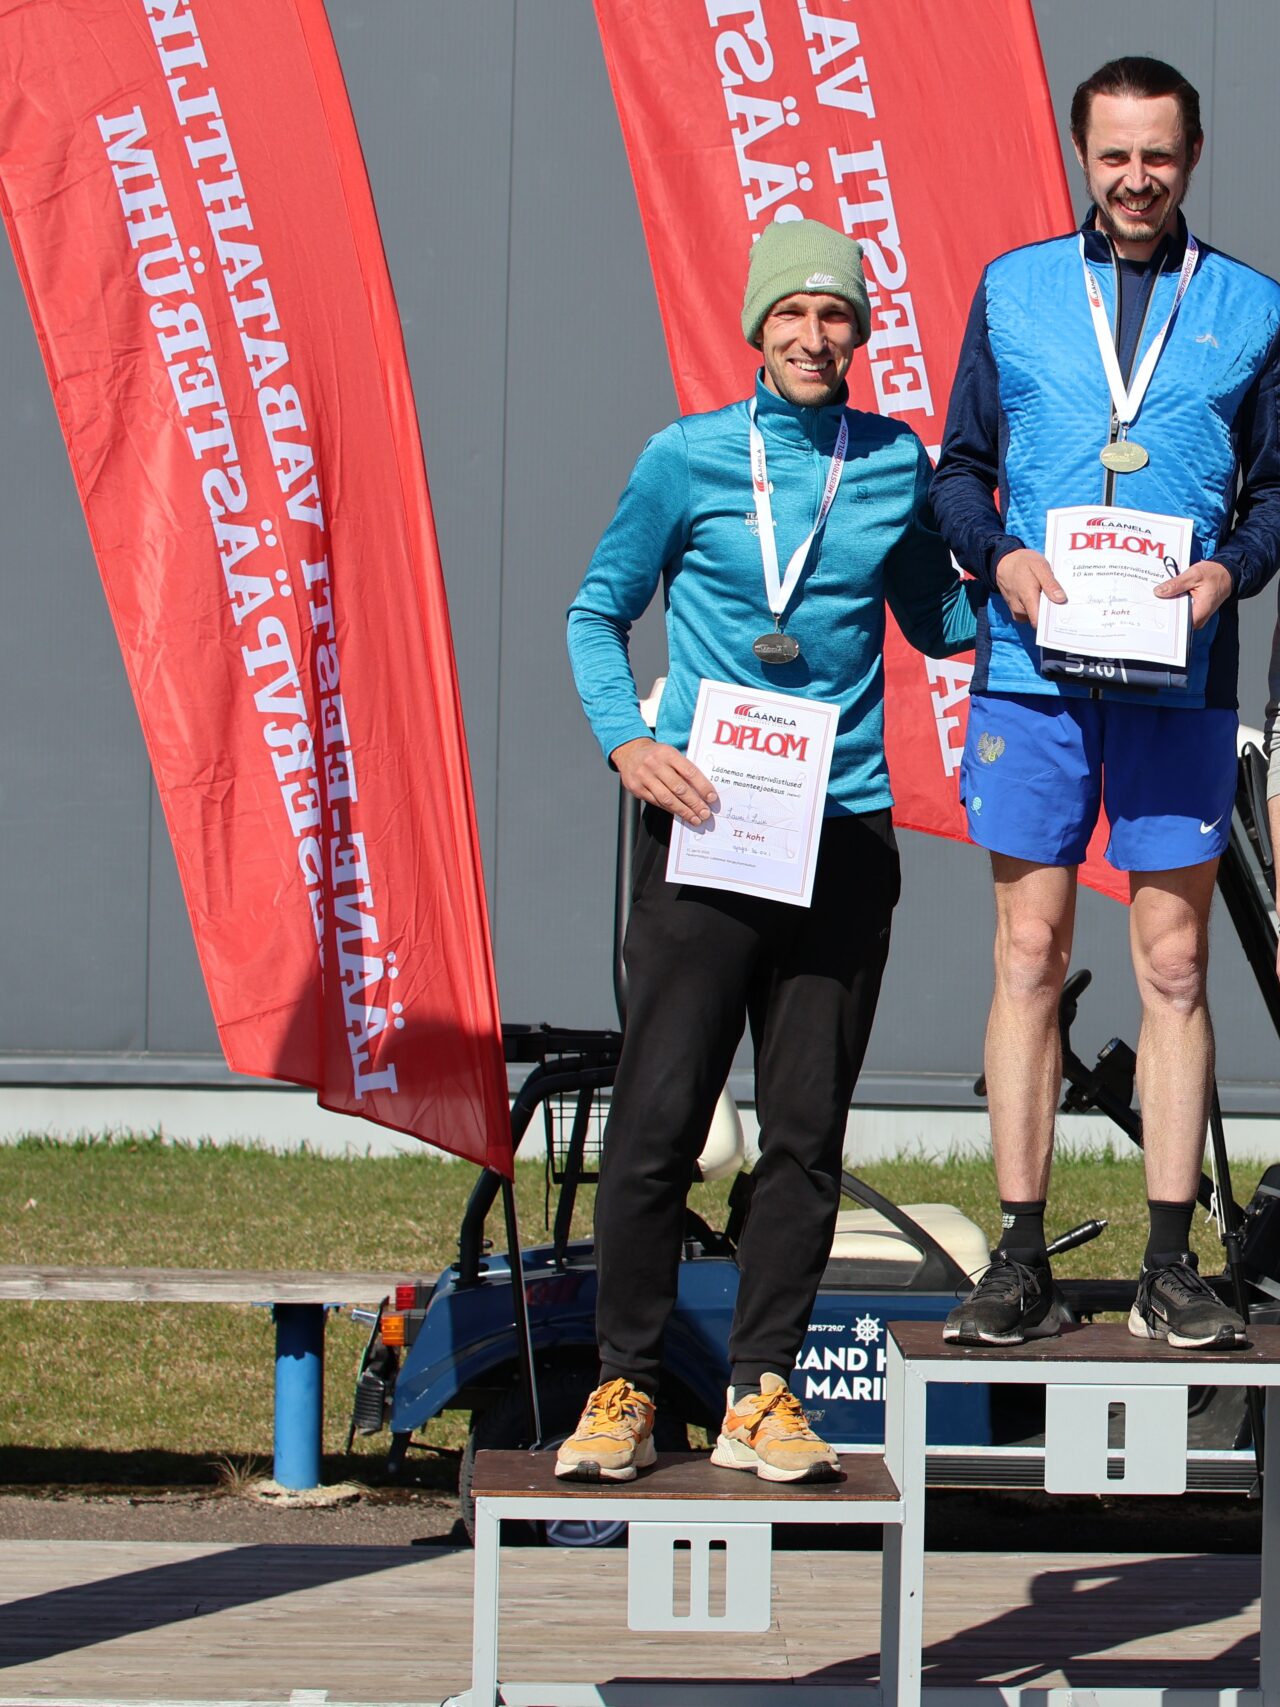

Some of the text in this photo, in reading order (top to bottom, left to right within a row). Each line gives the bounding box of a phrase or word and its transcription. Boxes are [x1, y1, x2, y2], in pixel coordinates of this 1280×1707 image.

[811, 272, 835, 284] NIKE
[1068, 532, 1166, 559] DIPLOM
[712, 719, 809, 762] DIPLOM
[712, 765, 802, 789] Läänemaa meistrivõistlused
[720, 777, 730, 785] km
[733, 780, 785, 796] maanteejooksus
[746, 832, 765, 842] koht
[805, 1376, 887, 1400] MARI
[672, 1539, 727, 1617] II
